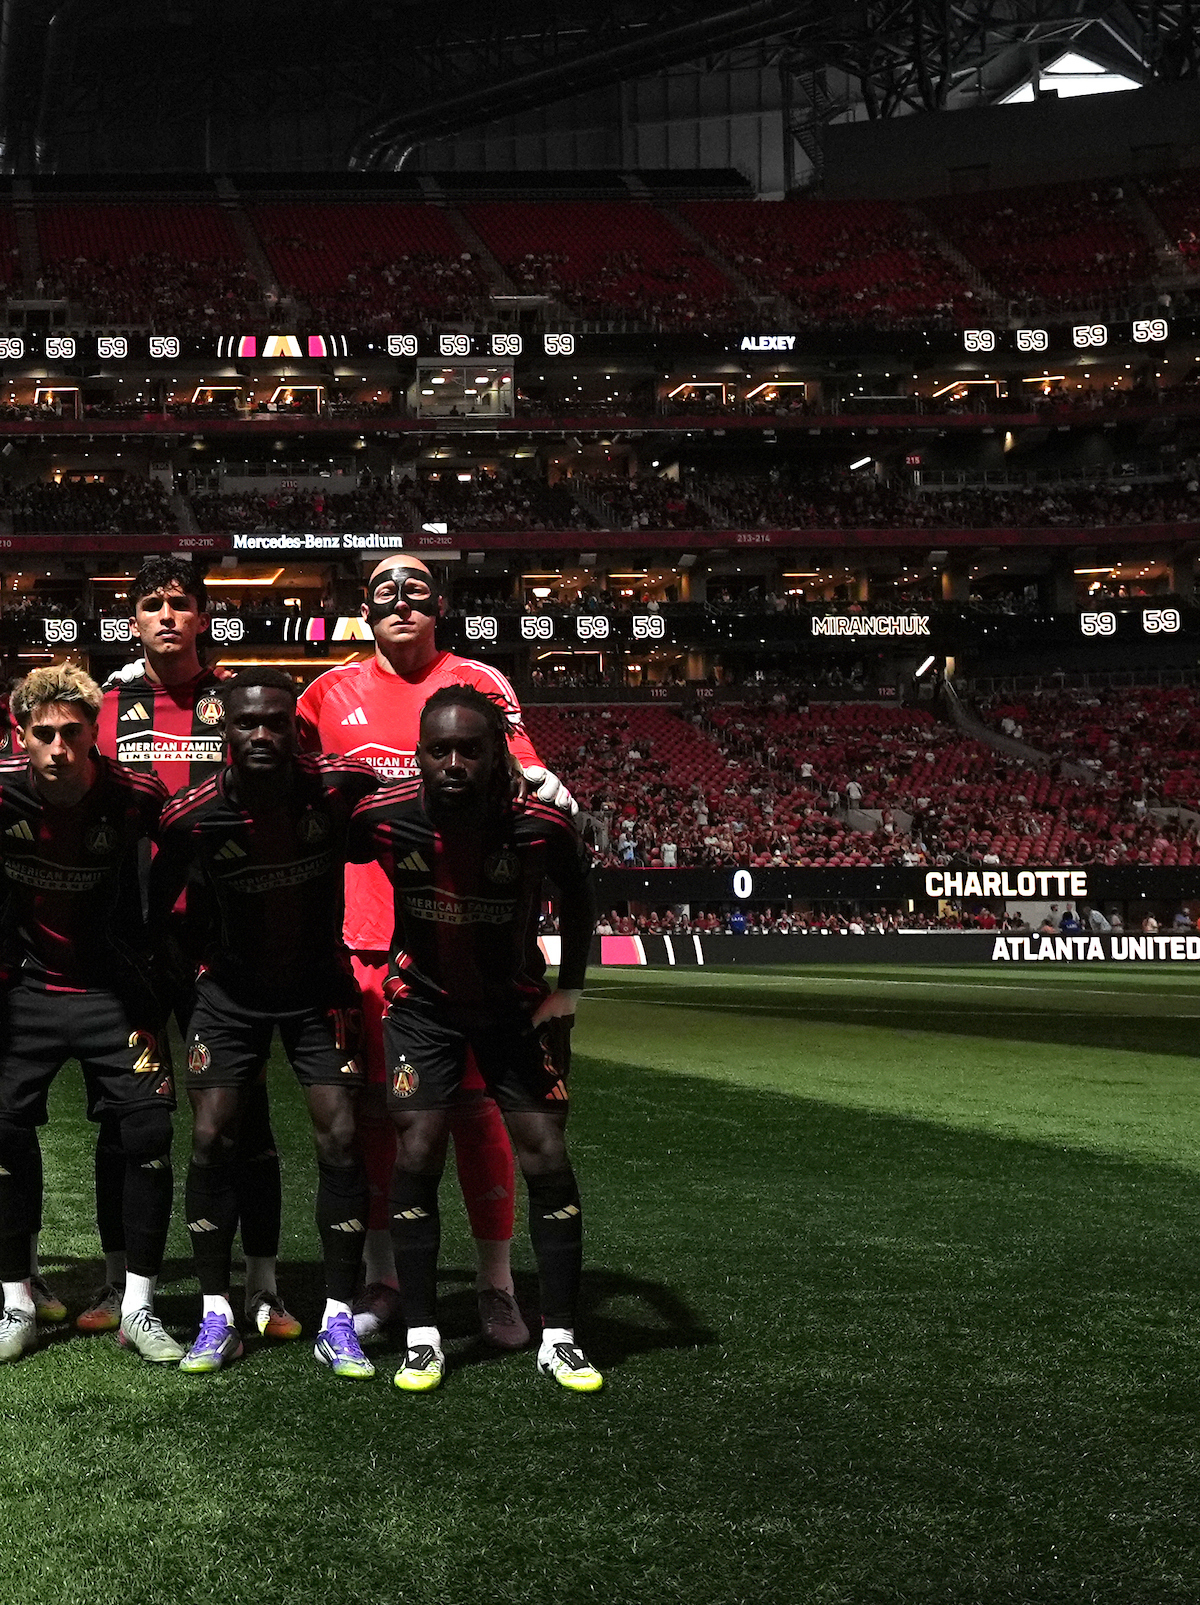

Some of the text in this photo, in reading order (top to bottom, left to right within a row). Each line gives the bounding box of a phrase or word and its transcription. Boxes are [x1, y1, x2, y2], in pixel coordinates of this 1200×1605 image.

[388, 334, 574, 356] 59 59 59 59
[741, 336, 795, 350] ALEXEY
[964, 319, 1168, 351] 59 59 59 59
[46, 338, 75, 358] 59
[98, 337, 127, 358] 59
[150, 337, 179, 357] 59
[234, 533, 403, 549] Mercedes-Benz Stadium
[737, 534, 771, 543] 213-214
[45, 618, 245, 642] 59 59 59
[465, 615, 665, 639] 59 59 59 59
[811, 616, 930, 636] MIRANCHUK
[1081, 609, 1180, 635] 59 59
[650, 688, 668, 697] 111C
[696, 688, 714, 697] 112C
[118, 741, 222, 752] AMERICAN FAMILY
[403, 757, 418, 767] FA
[5, 860, 103, 882] AMERICAN FAMI
[734, 870, 752, 898] 0
[926, 871, 1087, 896] CHARLOTTE
[466, 901, 514, 914] FAMILY
[992, 937, 1200, 960] ATLANTA UNITED
[128, 1030, 159, 1073] 2
